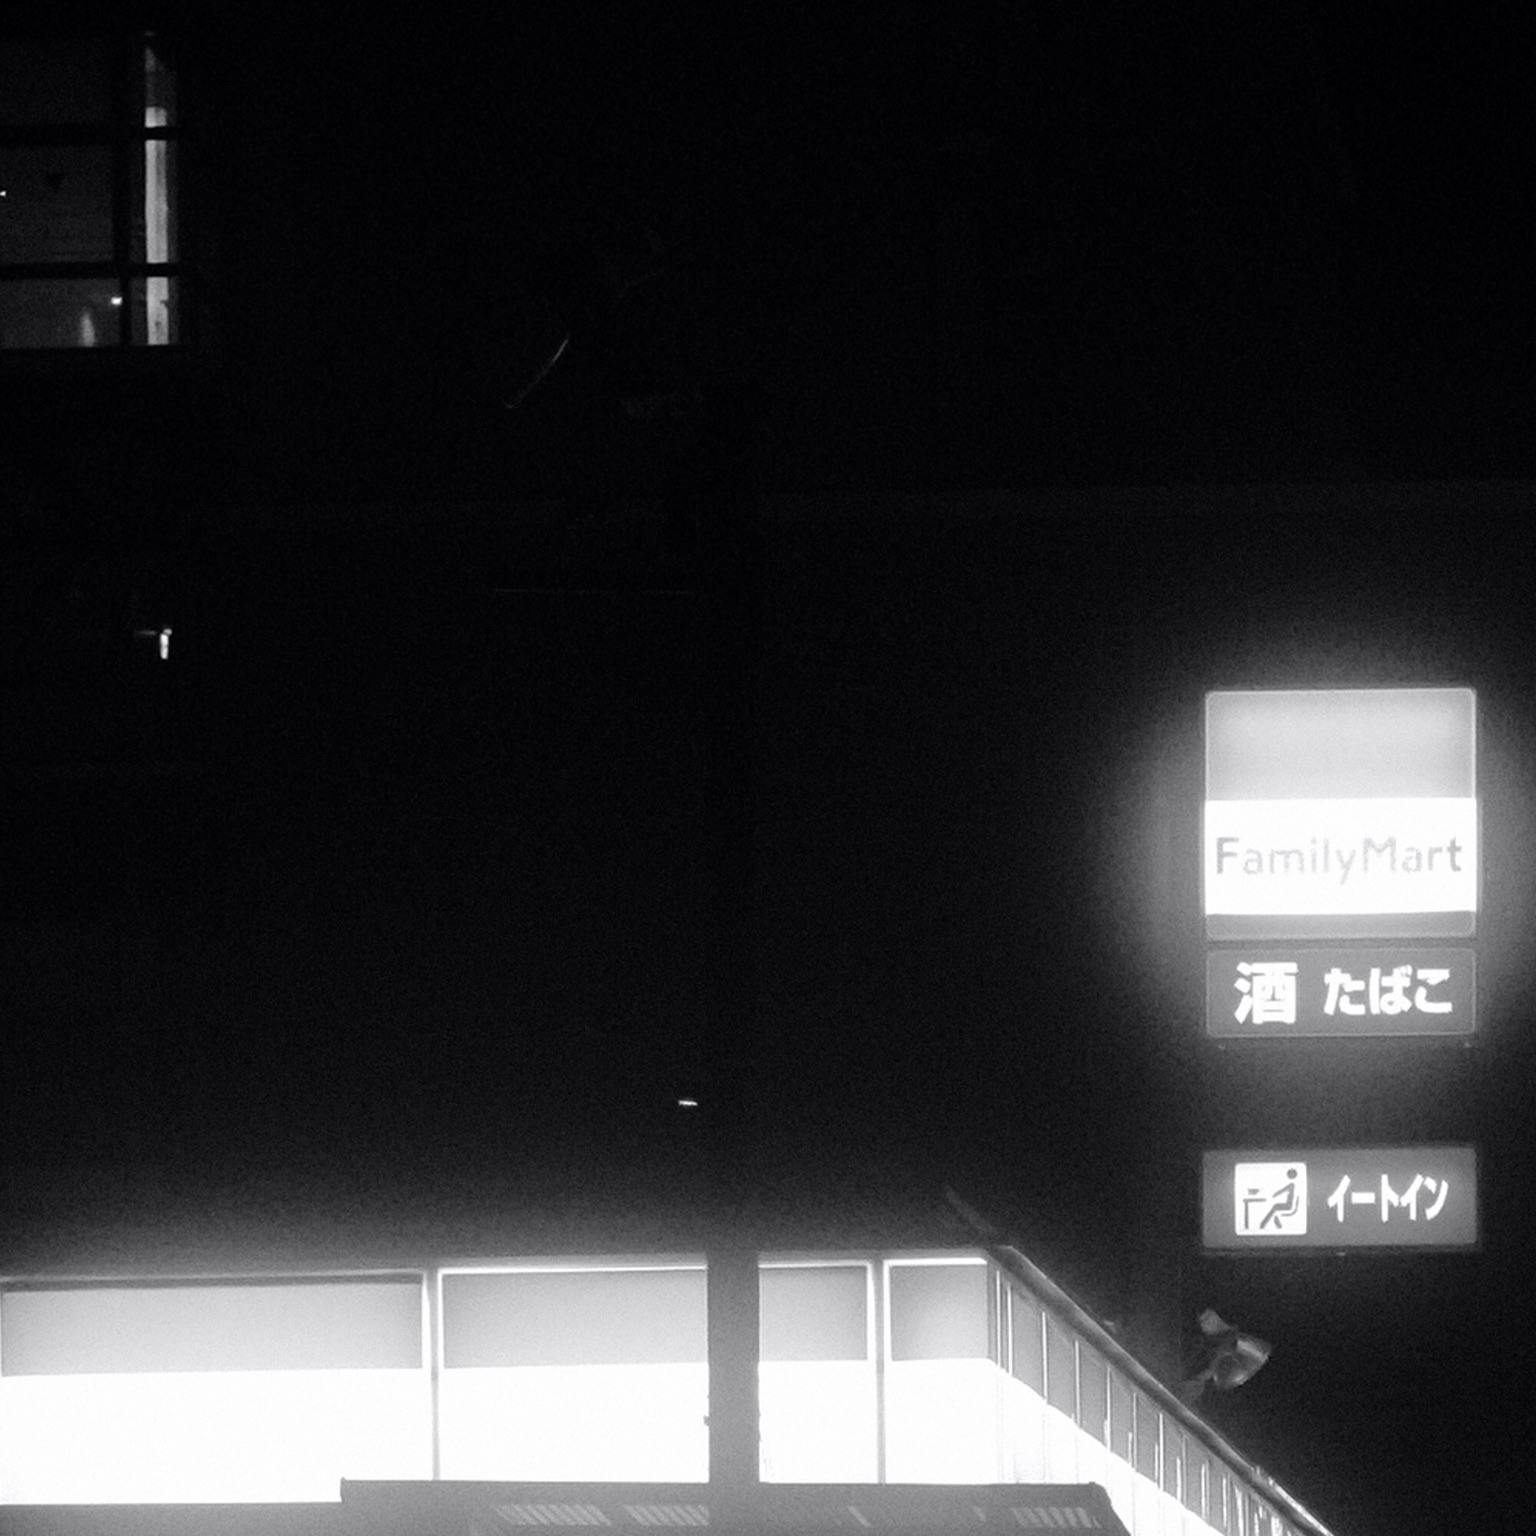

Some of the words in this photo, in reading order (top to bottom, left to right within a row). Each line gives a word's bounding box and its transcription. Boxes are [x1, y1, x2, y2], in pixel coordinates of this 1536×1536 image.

[1215, 835, 1464, 885] FamilyMart
[1233, 960, 1298, 1024] 酒
[1323, 964, 1453, 1017] たばこ
[1326, 1172, 1449, 1223] イートイン
